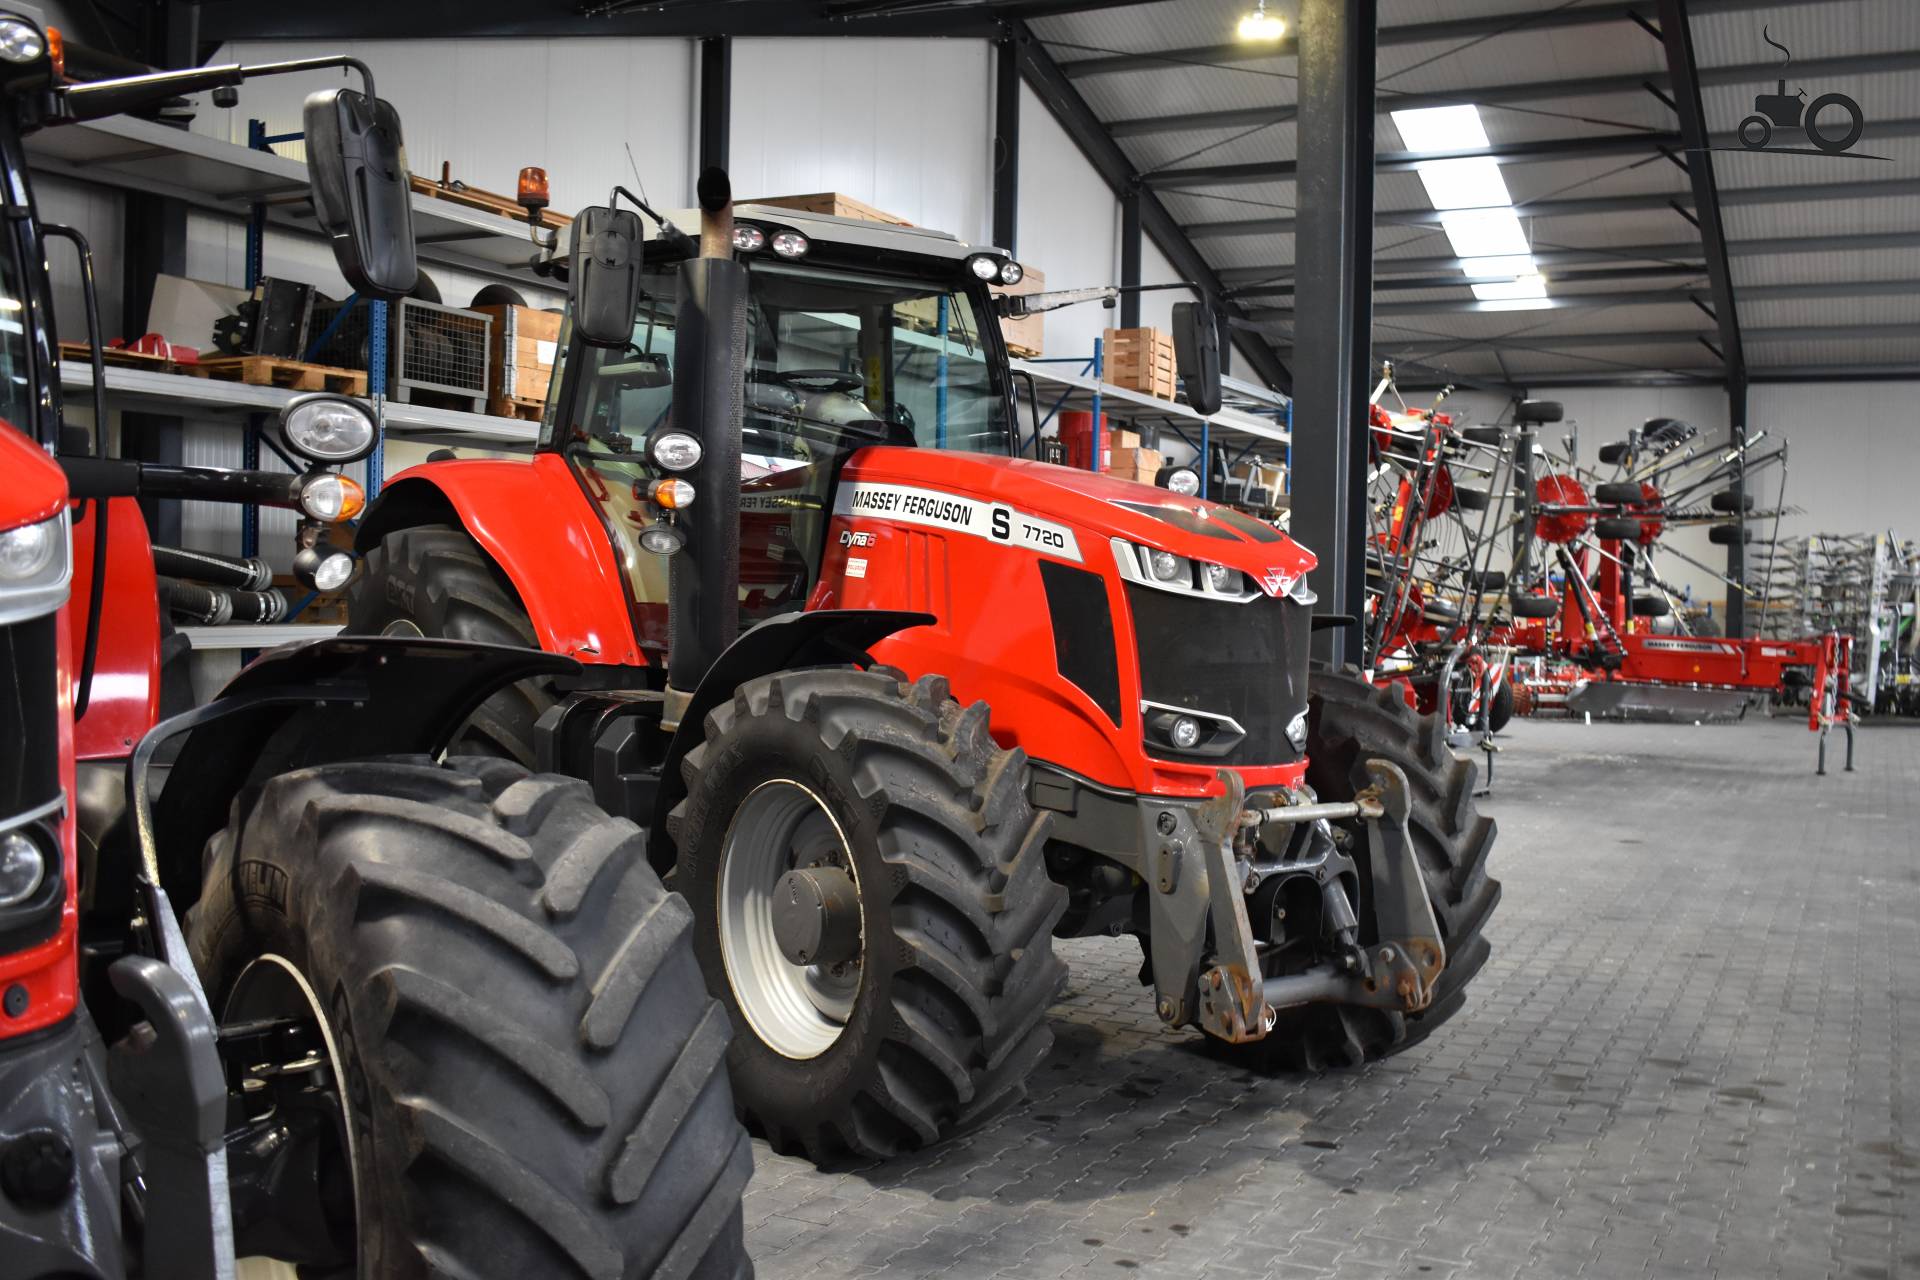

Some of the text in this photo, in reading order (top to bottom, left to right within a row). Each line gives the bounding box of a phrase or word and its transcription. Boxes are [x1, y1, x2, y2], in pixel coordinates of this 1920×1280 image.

[852, 490, 1064, 549] MASSEY FERGUSON S 7720
[1647, 640, 1713, 651] MASSEY FERGUSON
